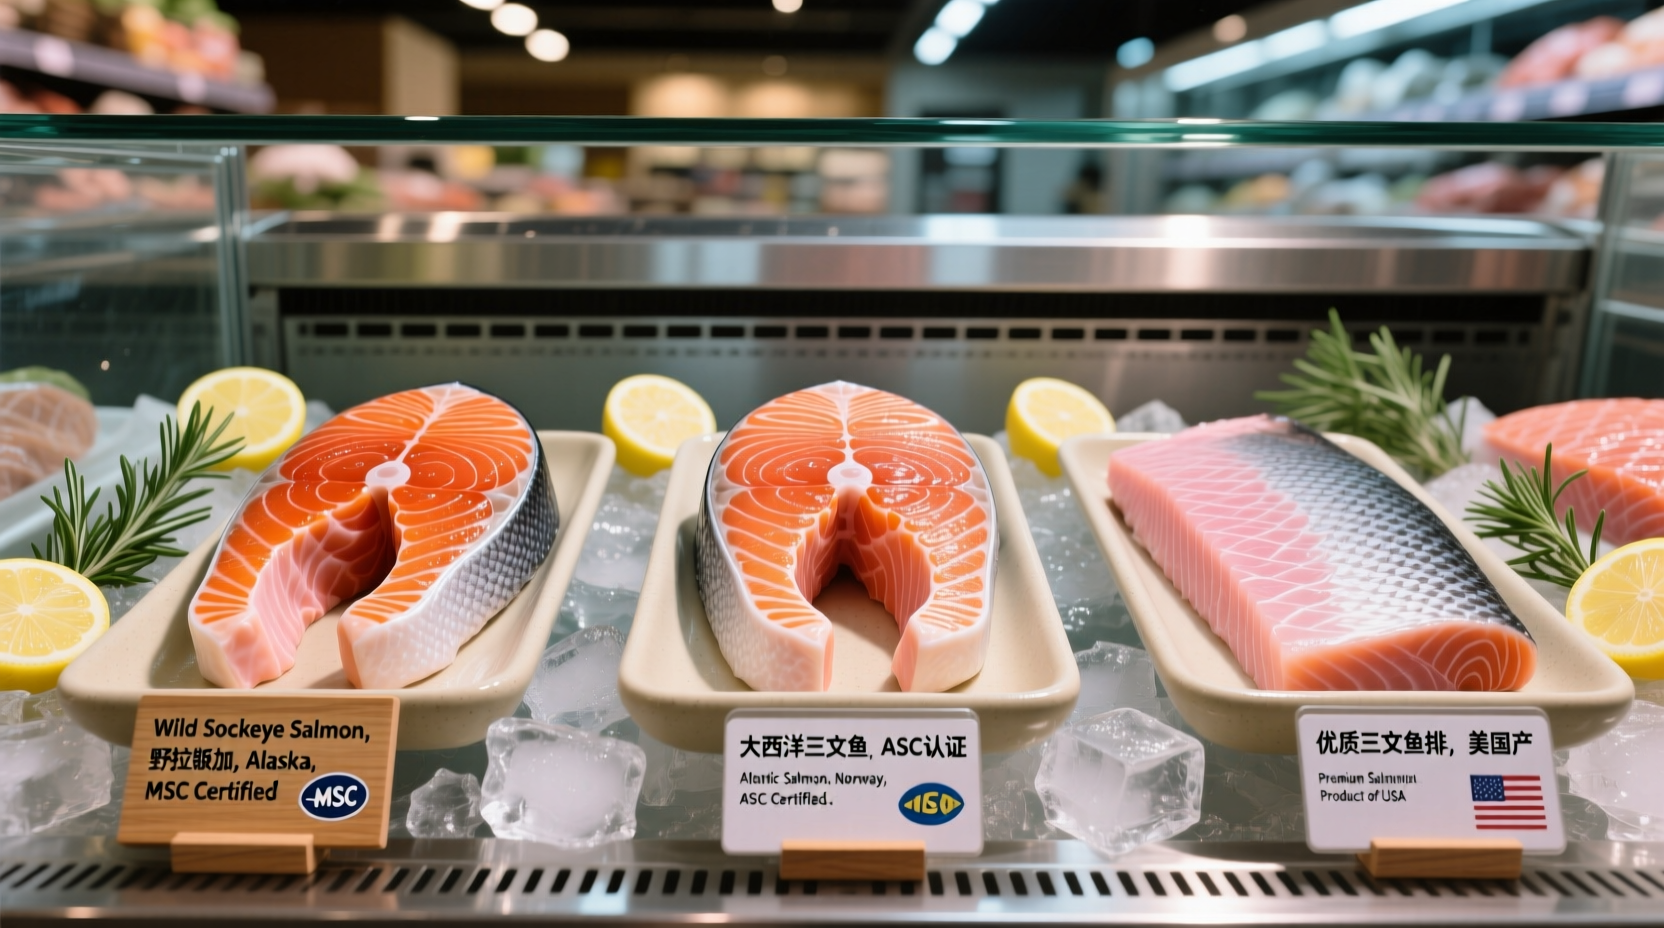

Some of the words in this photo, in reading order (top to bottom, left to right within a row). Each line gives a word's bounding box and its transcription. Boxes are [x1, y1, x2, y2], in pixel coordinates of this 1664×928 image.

[154, 718, 198, 738] Wild
[203, 719, 285, 744] Sockeye
[290, 720, 370, 743] Salmon,
[1469, 730, 1533, 755] 美国产
[881, 735, 967, 759] ASC认证
[246, 750, 316, 773] Alaska,
[145, 781, 189, 801] MSC
[836, 773, 887, 788] Norway,
[313, 785, 358, 808] MSC
[740, 793, 767, 806] ASC
[1320, 789, 1364, 802] Product
[1367, 789, 1380, 802] of
[1381, 789, 1407, 802] USA
